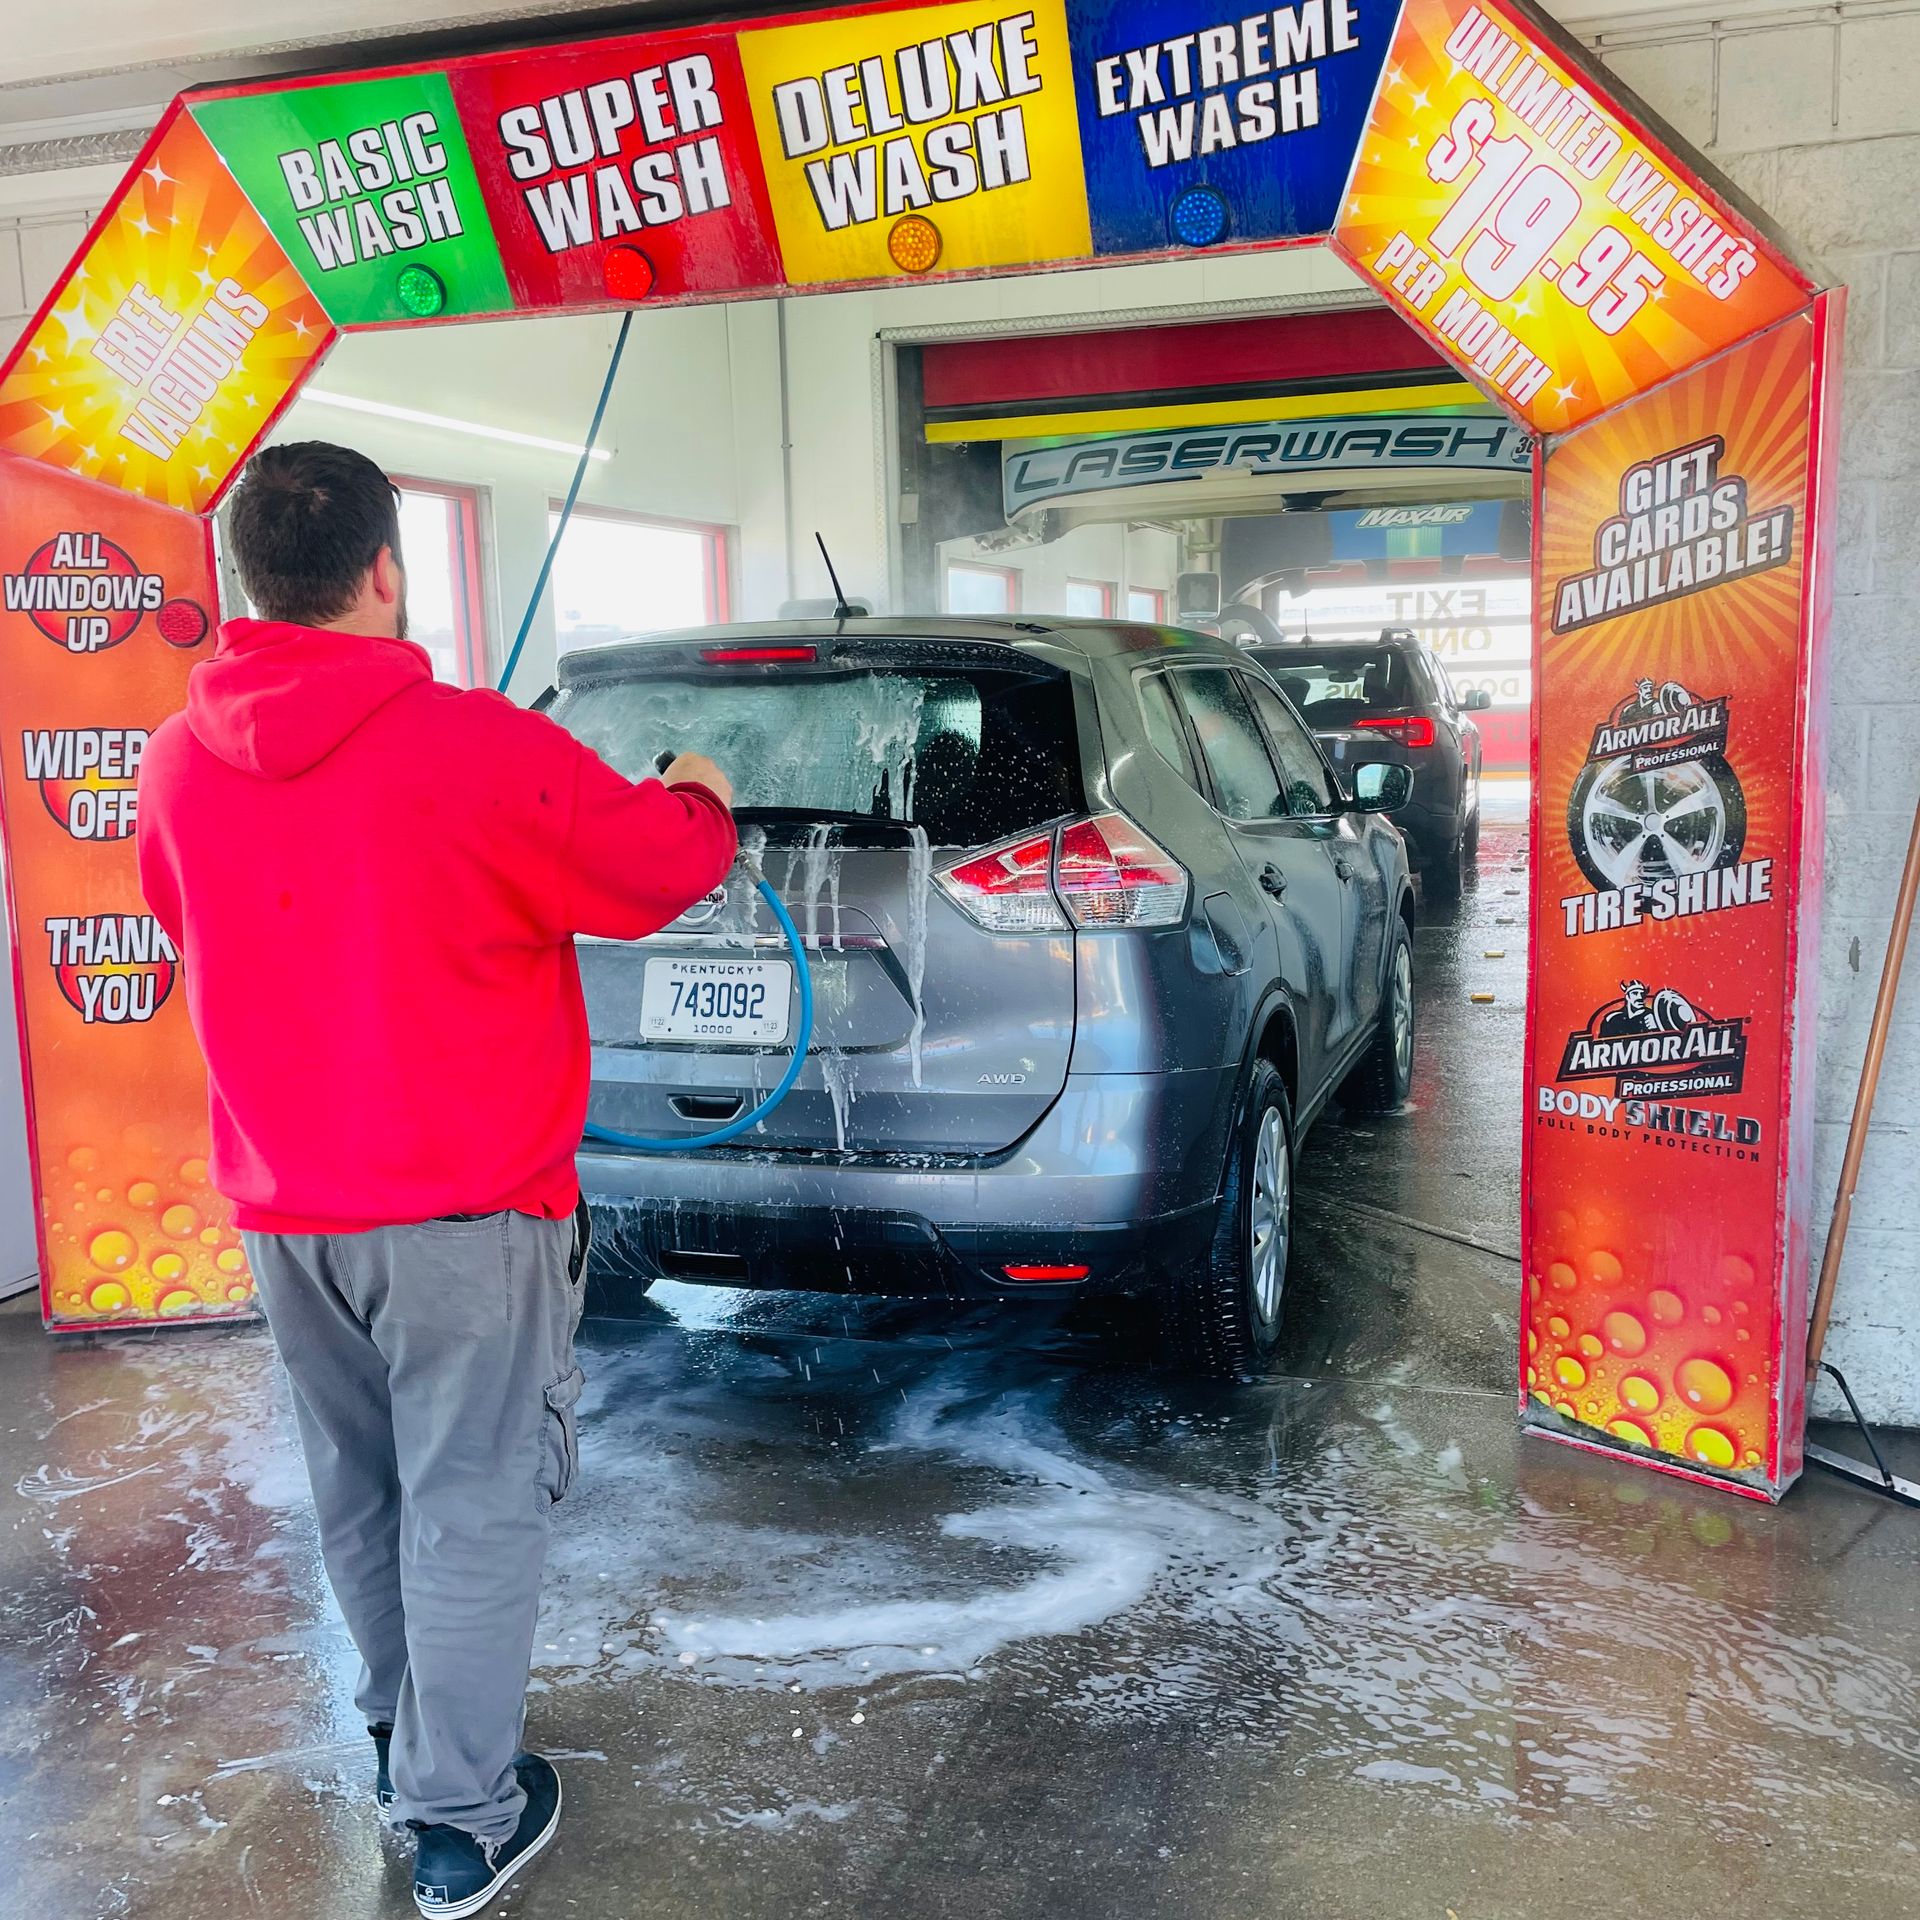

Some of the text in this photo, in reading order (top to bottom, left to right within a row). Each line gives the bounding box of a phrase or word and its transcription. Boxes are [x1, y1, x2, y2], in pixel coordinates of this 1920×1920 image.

[772, 10, 1042, 160] DELUXE
[1095, 0, 1360, 117] EXTREME
[498, 53, 724, 181] SUPER
[1138, 68, 1319, 168] WASH
[1444, 5, 1758, 300] UNLIMITED WASHES
[278, 111, 448, 213] BASIC
[523, 135, 731, 254] WASH
[804, 105, 1031, 232] WASH
[297, 177, 464, 272] WASH
[1426, 98, 1666, 336] $19.95
[91, 281, 183, 388] FREE
[1373, 230, 1554, 407] PER MONTH
[119, 277, 270, 462] VACUUMS
[1013, 426, 1508, 493] LASERWASH
[1626, 444, 1717, 515] GIFT
[52, 532, 108, 569] ALL
[1600, 484, 1738, 567] CARDS
[3, 574, 164, 611] WINDOWS
[1557, 514, 1785, 627] AVAILABLE!
[67, 617, 110, 653] UP
[22, 729, 150, 780] WIPER
[69, 789, 138, 840] OFF
[1561, 858, 1773, 937] TIRE SHINE
[45, 915, 178, 965] THANK
[680, 964, 754, 975] KENTUCKY
[77, 974, 155, 1023] YOU
[670, 981, 766, 1019] 743092
[693, 1025, 733, 1034] 10000
[977, 1073, 1026, 1084] AWD
[1538, 1086, 1762, 1146] BODY SHIELD
[1537, 1116, 1575, 1132] FULL
[1587, 1124, 1631, 1141] BODY
